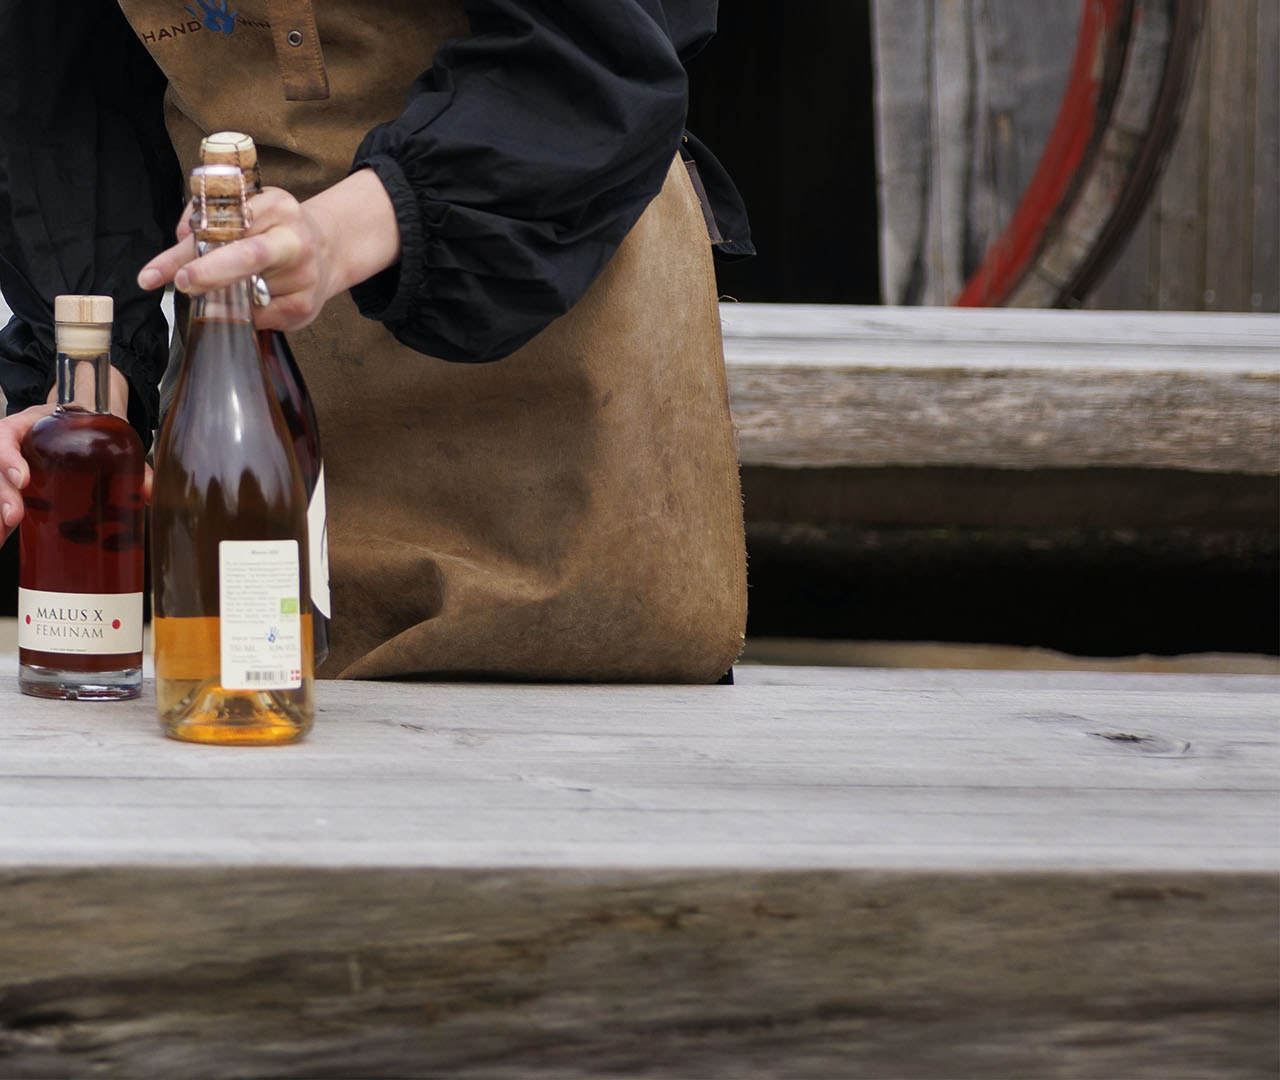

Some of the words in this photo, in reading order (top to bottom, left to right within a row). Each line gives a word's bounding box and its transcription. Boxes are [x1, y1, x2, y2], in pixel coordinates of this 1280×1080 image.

[141, 20, 202, 44] HAND
[36, 607, 88, 622] MALUS
[93, 609, 103, 622] X
[36, 623, 104, 639] FEMINAM
